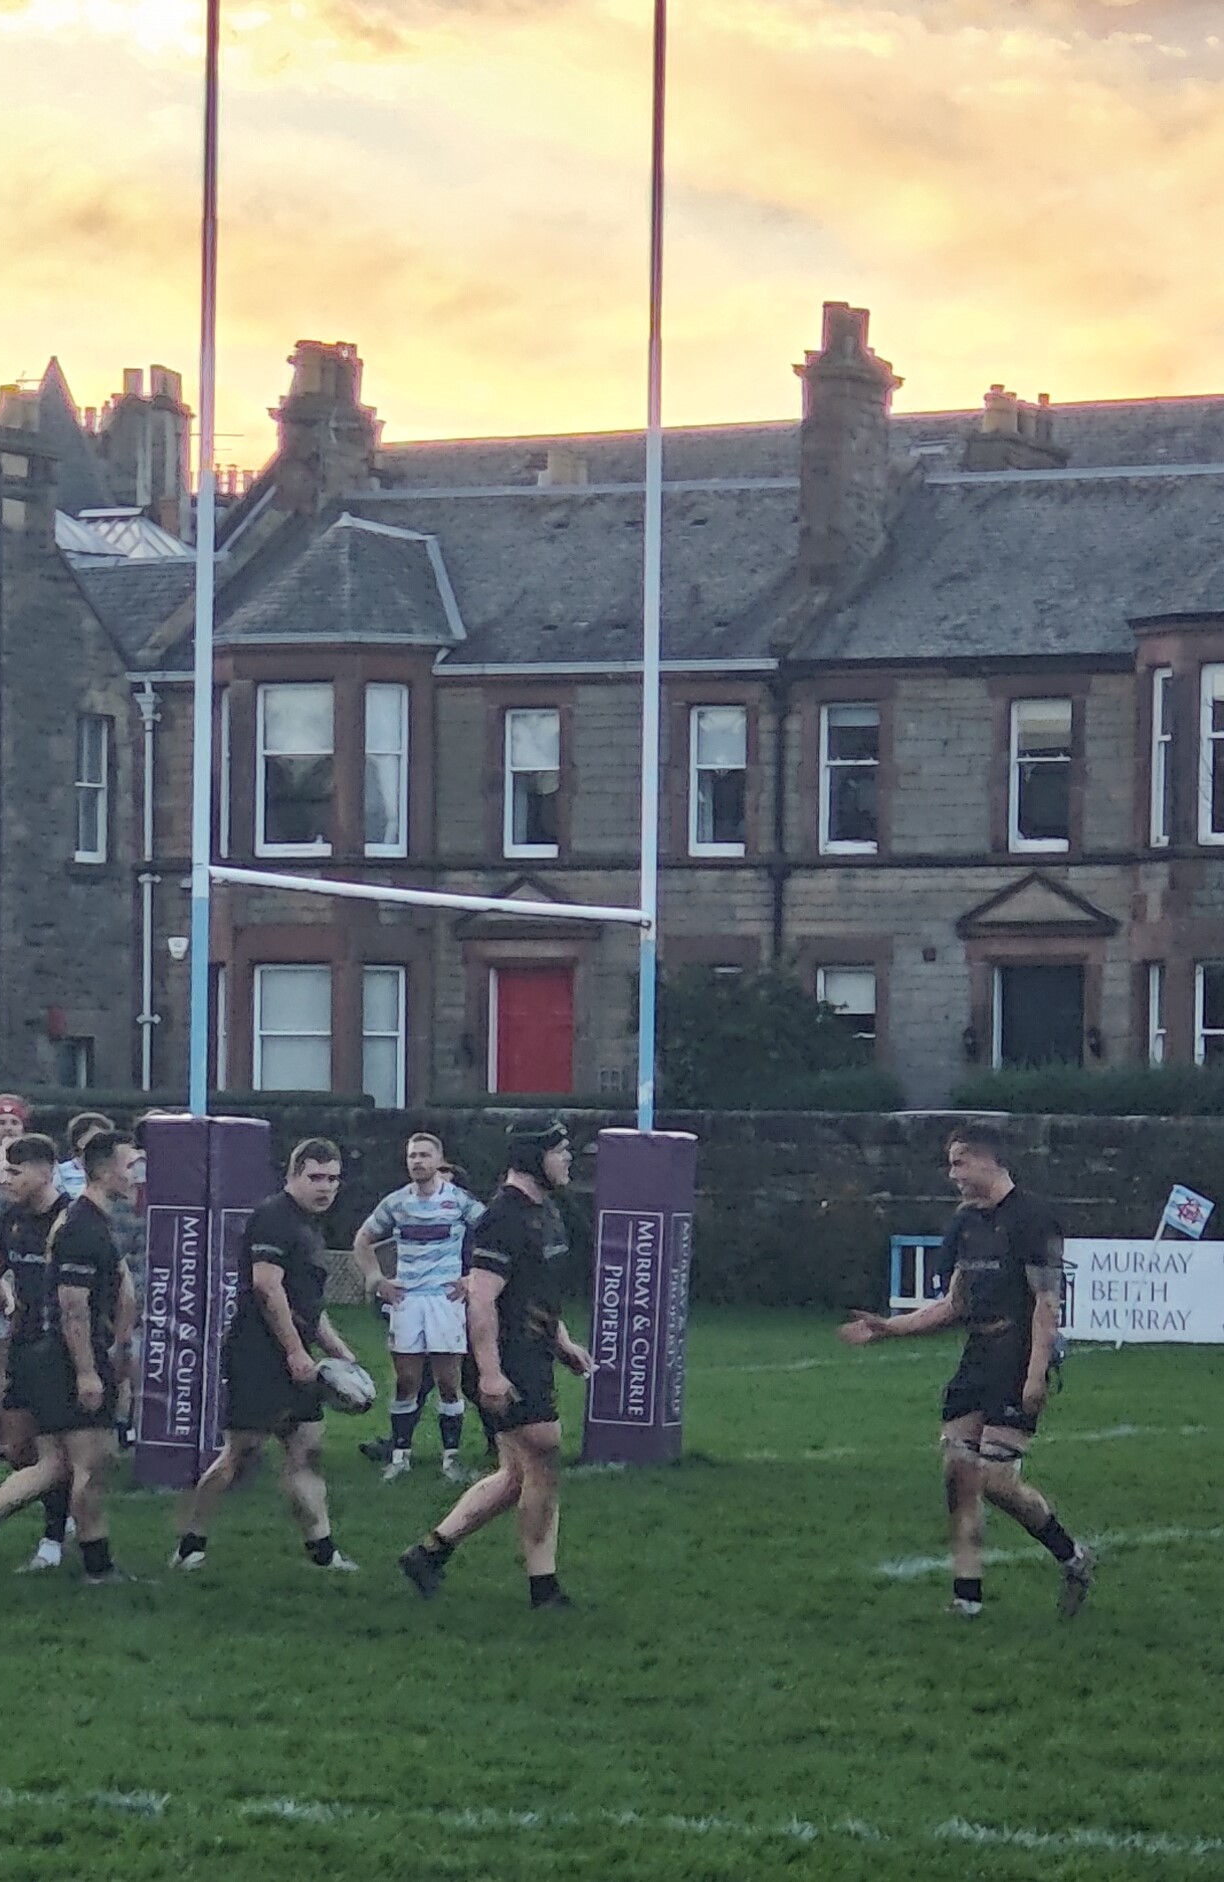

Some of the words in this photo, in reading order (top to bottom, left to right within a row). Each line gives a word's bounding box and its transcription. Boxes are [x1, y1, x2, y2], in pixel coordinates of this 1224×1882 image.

[179, 1215, 200, 1317] MURRAY
[633, 1219, 655, 1308] MURRAY
[1091, 1251, 1194, 1274] MURRAY
[1091, 1280, 1169, 1303] BEITH
[147, 1266, 171, 1383] PROPERTY
[179, 1322, 197, 1341] &
[599, 1264, 624, 1371] PROPERTY
[632, 1314, 651, 1333] &
[1090, 1308, 1192, 1331] MURRAY
[175, 1348, 196, 1436] CURRIE
[628, 1336, 650, 1417] CURRIE
